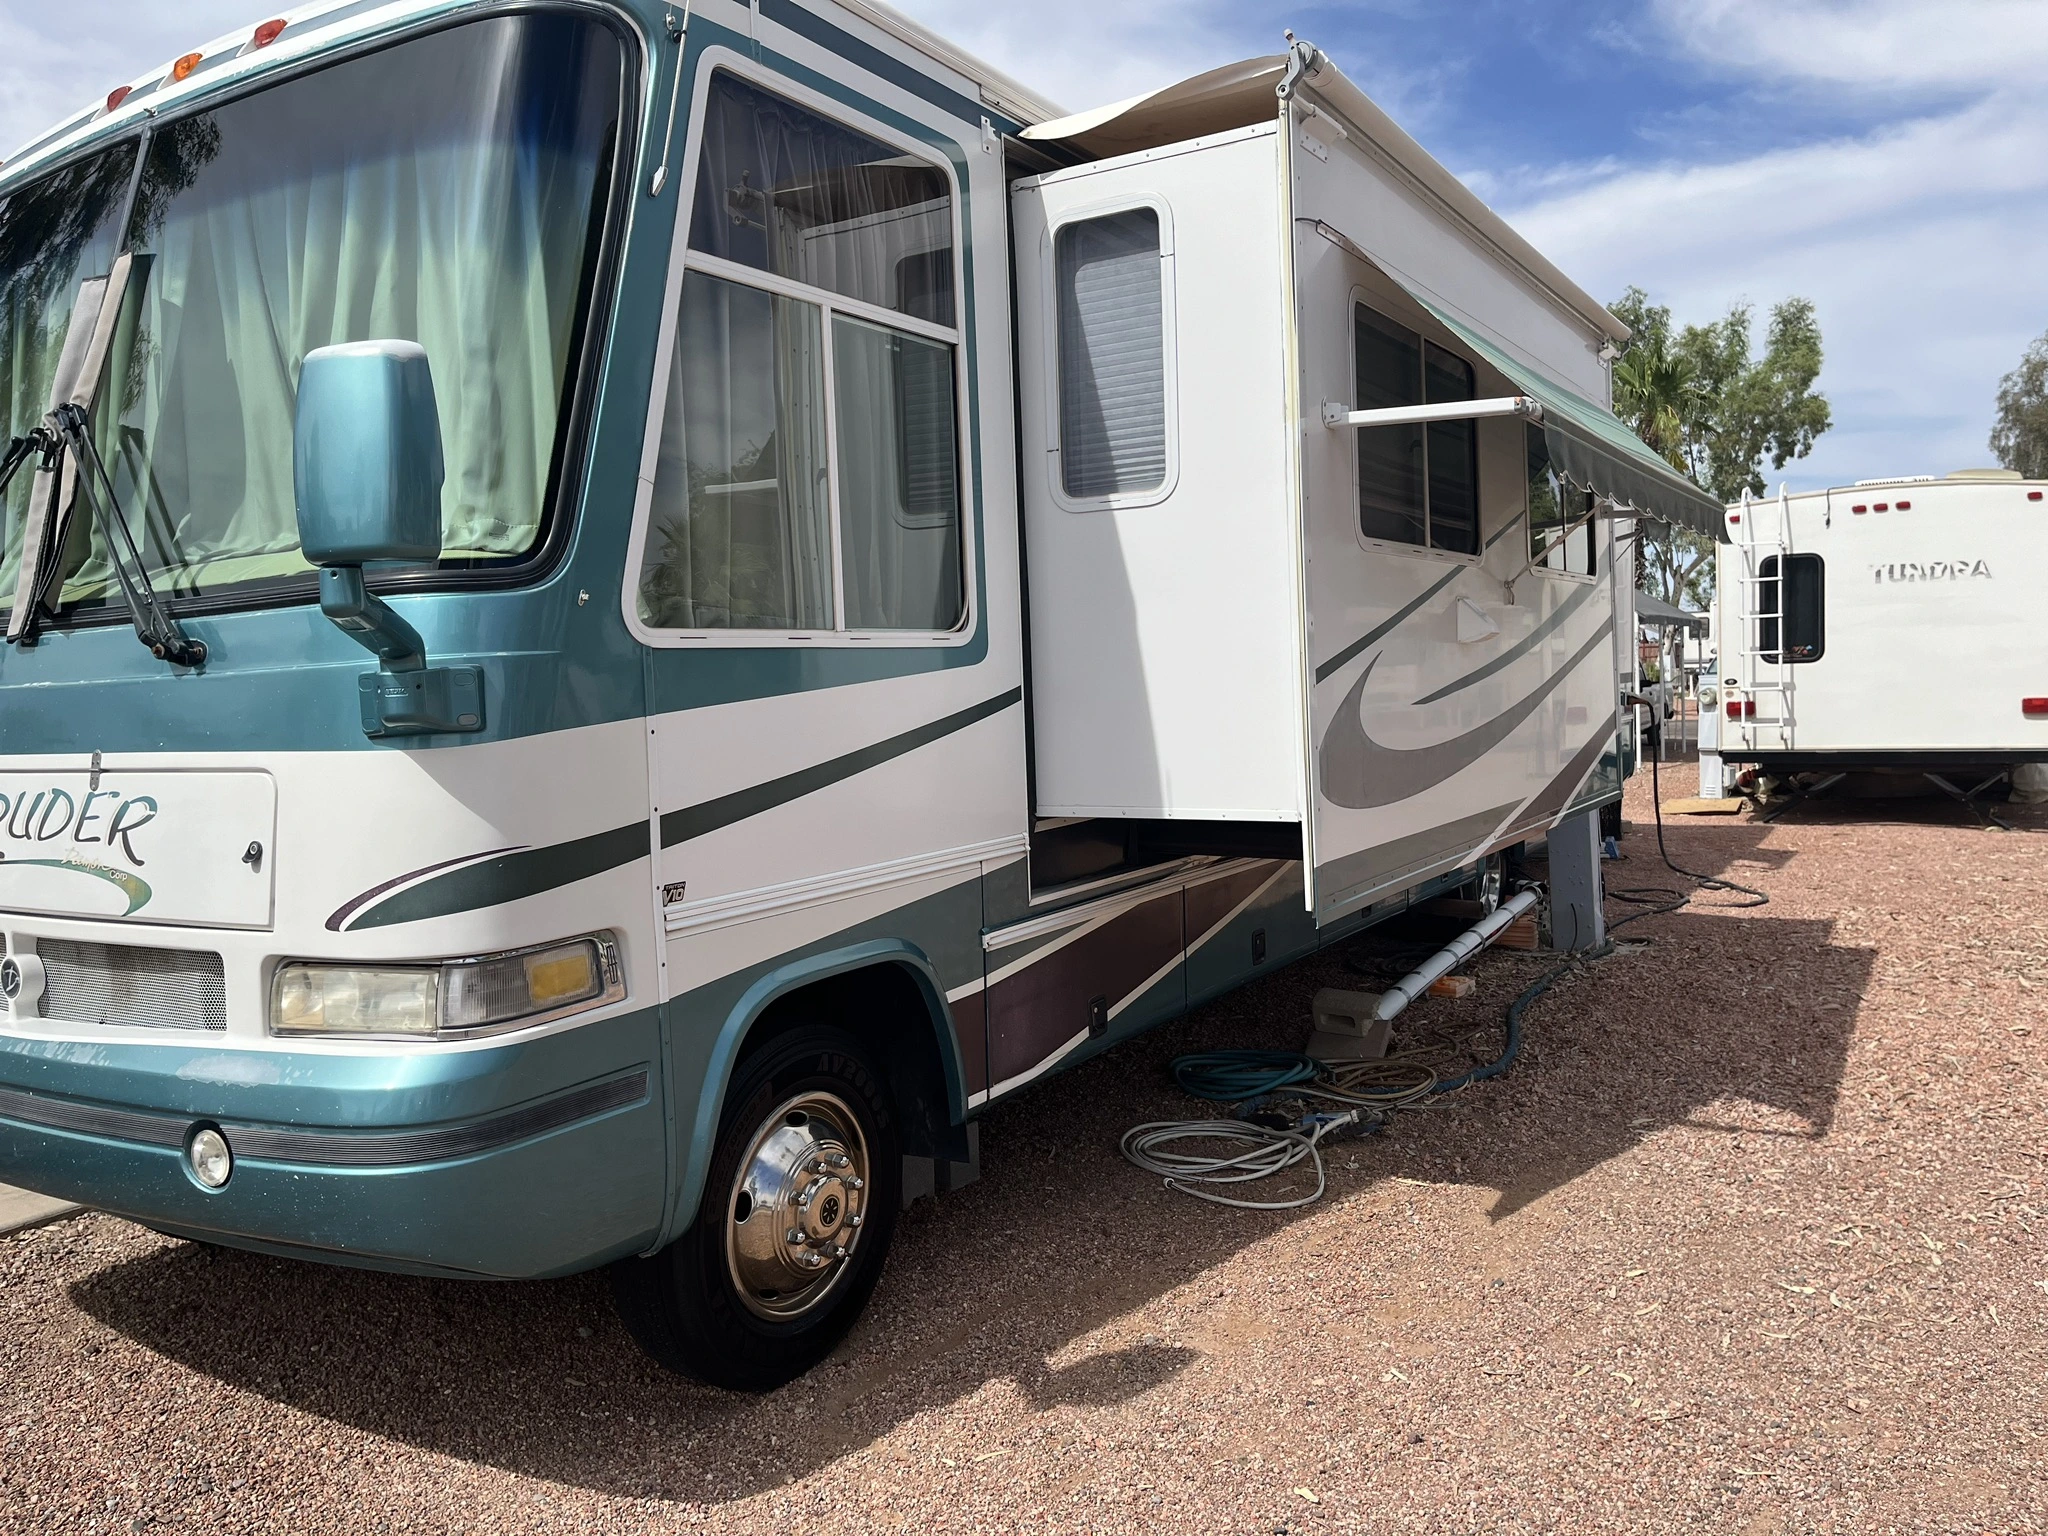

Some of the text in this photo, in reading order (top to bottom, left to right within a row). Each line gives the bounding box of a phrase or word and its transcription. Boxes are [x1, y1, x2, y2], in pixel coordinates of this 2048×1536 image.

[1867, 559, 1992, 584] TUNDRA
[109, 869, 128, 881] Corp
[662, 888, 684, 906] V10
